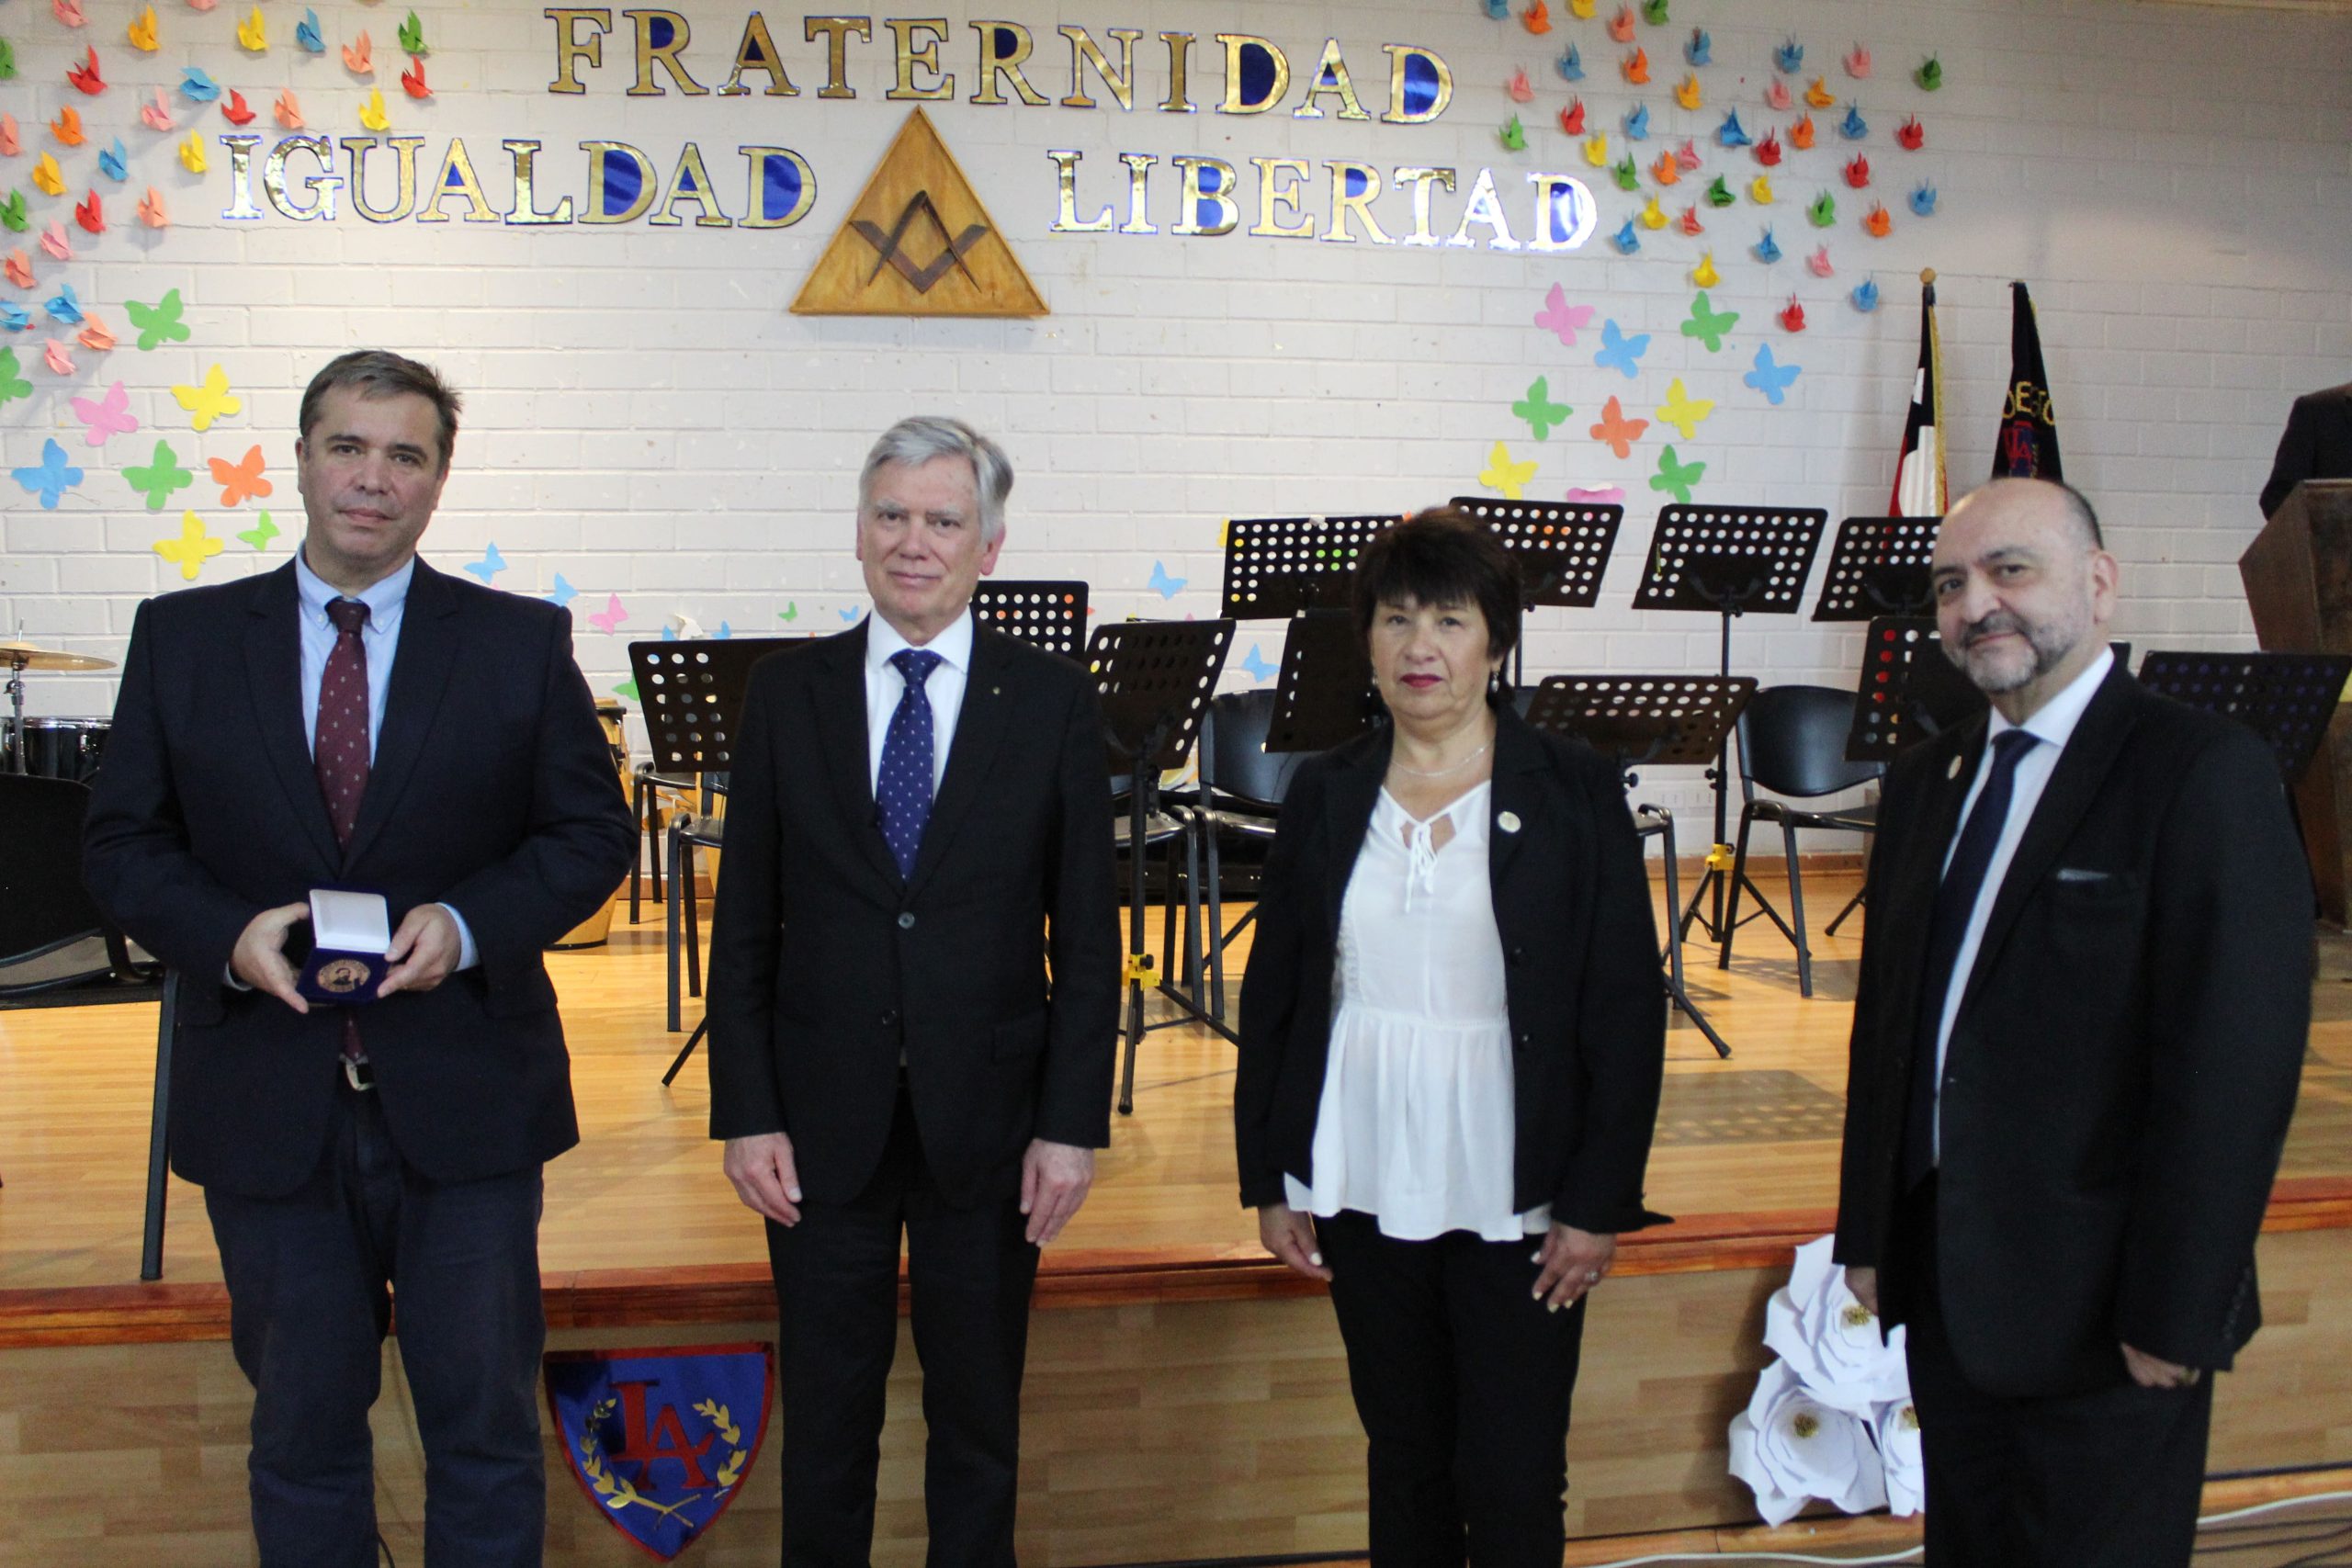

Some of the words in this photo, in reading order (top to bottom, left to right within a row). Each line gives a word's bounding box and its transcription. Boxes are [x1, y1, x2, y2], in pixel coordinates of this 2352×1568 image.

[544, 7, 1454, 124] FRATERNIDAD
[219, 134, 817, 229] IGUALDAD
[1046, 149, 1599, 253] LIBERTAD
